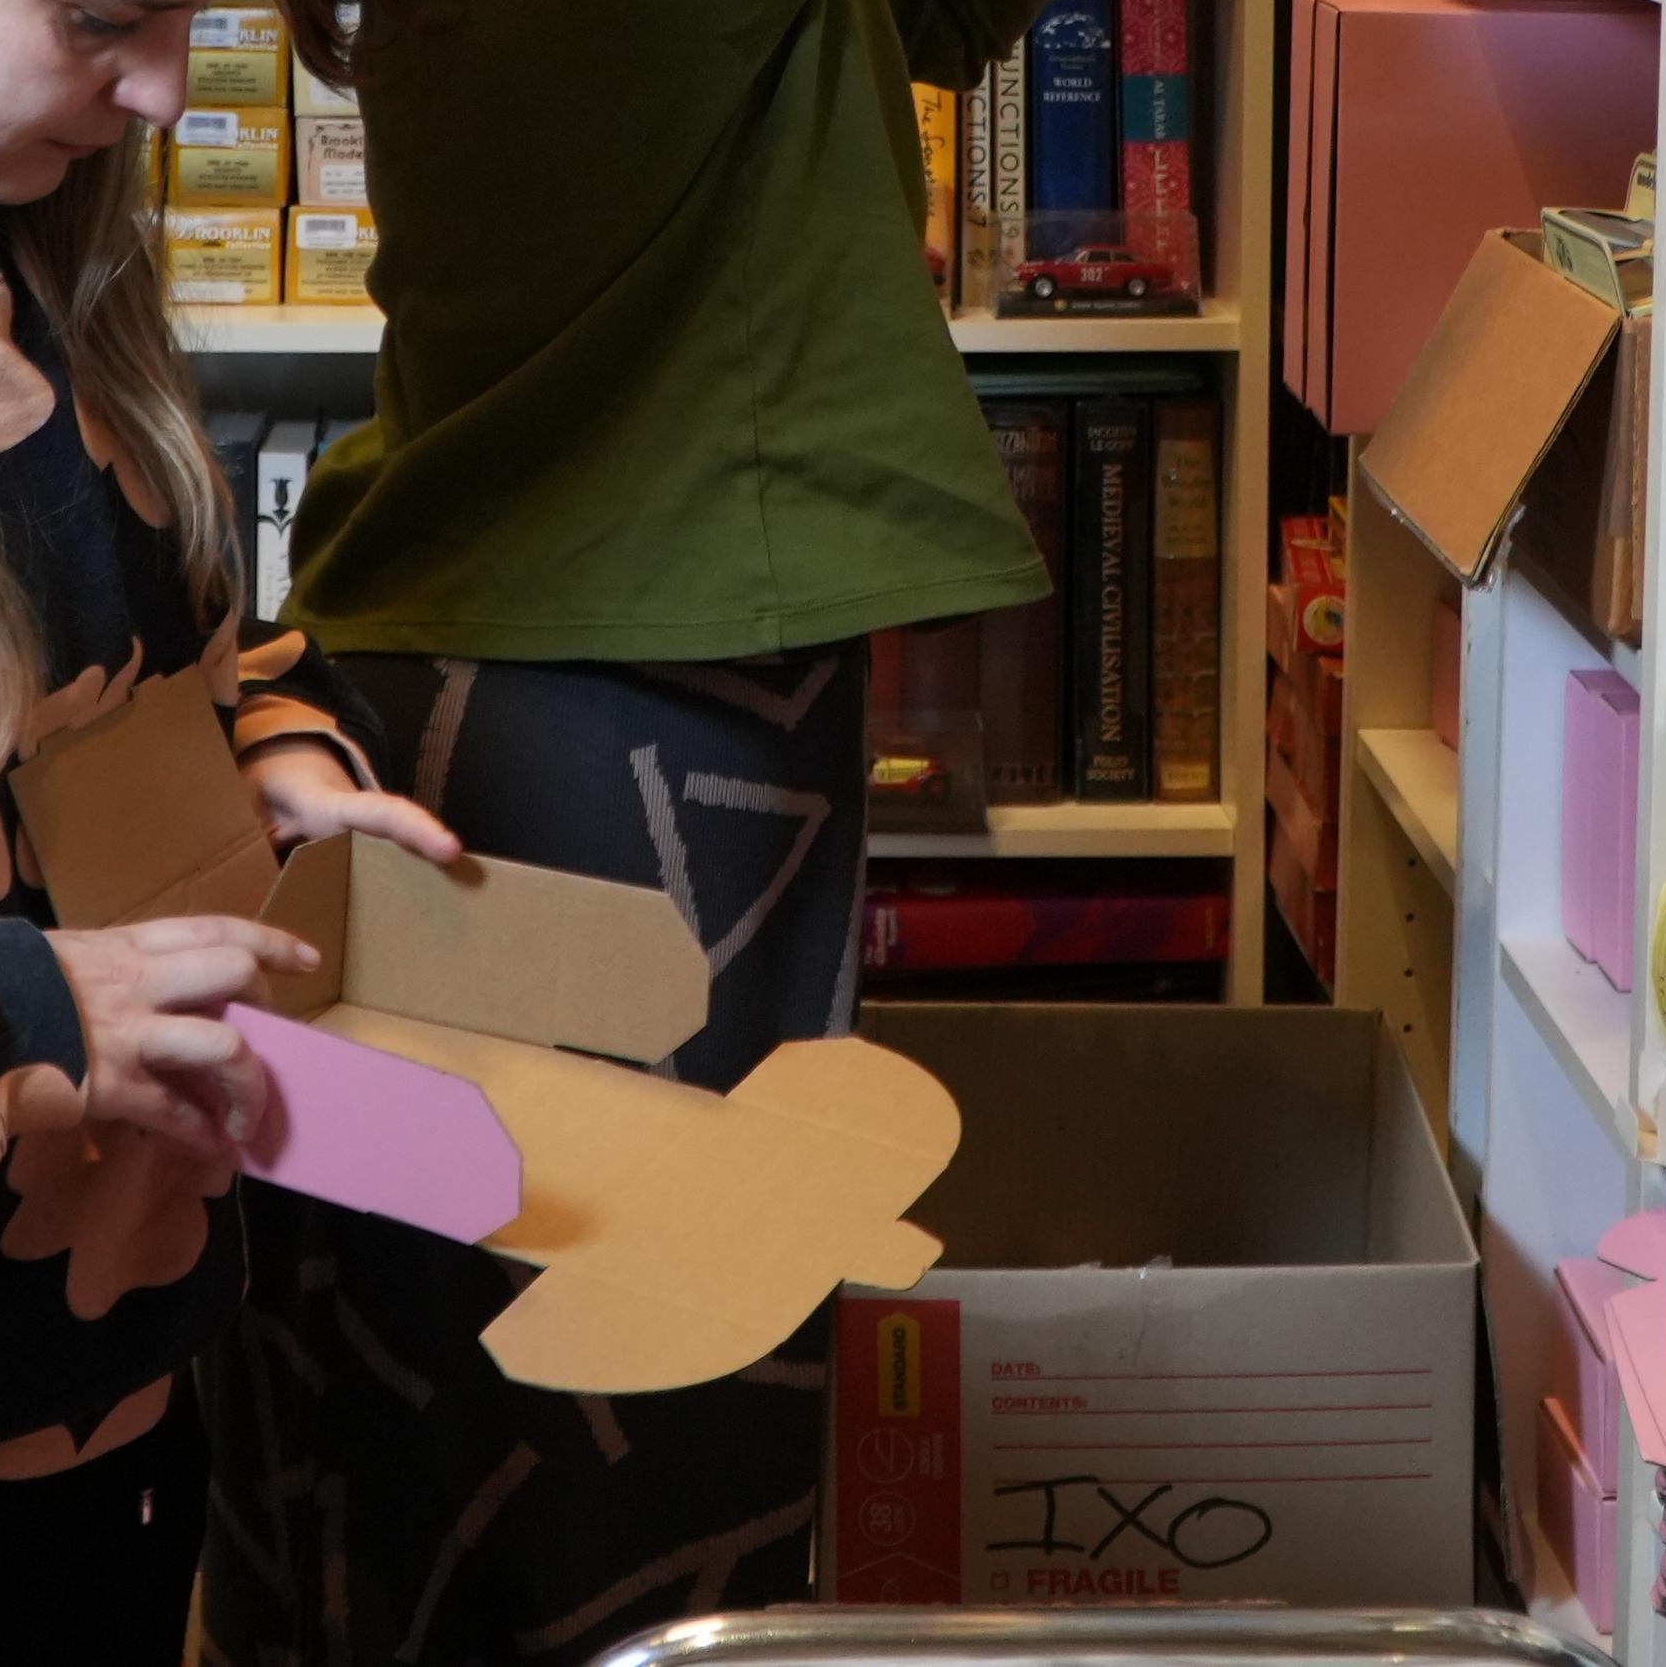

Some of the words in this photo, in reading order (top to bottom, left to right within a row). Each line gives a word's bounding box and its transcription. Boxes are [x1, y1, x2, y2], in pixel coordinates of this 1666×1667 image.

[238, 29, 278, 42] KLIN
[1053, 77, 1093, 87] WORLD
[1043, 92, 1102, 103] REFERENCE
[238, 127, 278, 140] KLIN
[181, 223, 271, 241] BROOKLIN
[1102, 464, 1123, 581] MEDIEVAL
[1100, 585, 1122, 742] CIVILISATION
[1086, 769, 1135, 781] SOCIETY
[894, 1326, 907, 1411] STANDARD
[991, 1362, 1041, 1377] DATE:
[991, 1397, 1088, 1411] CONTENTS:
[985, 1476, 1273, 1571] IXO
[1027, 1569, 1181, 1595] FRAGILE
